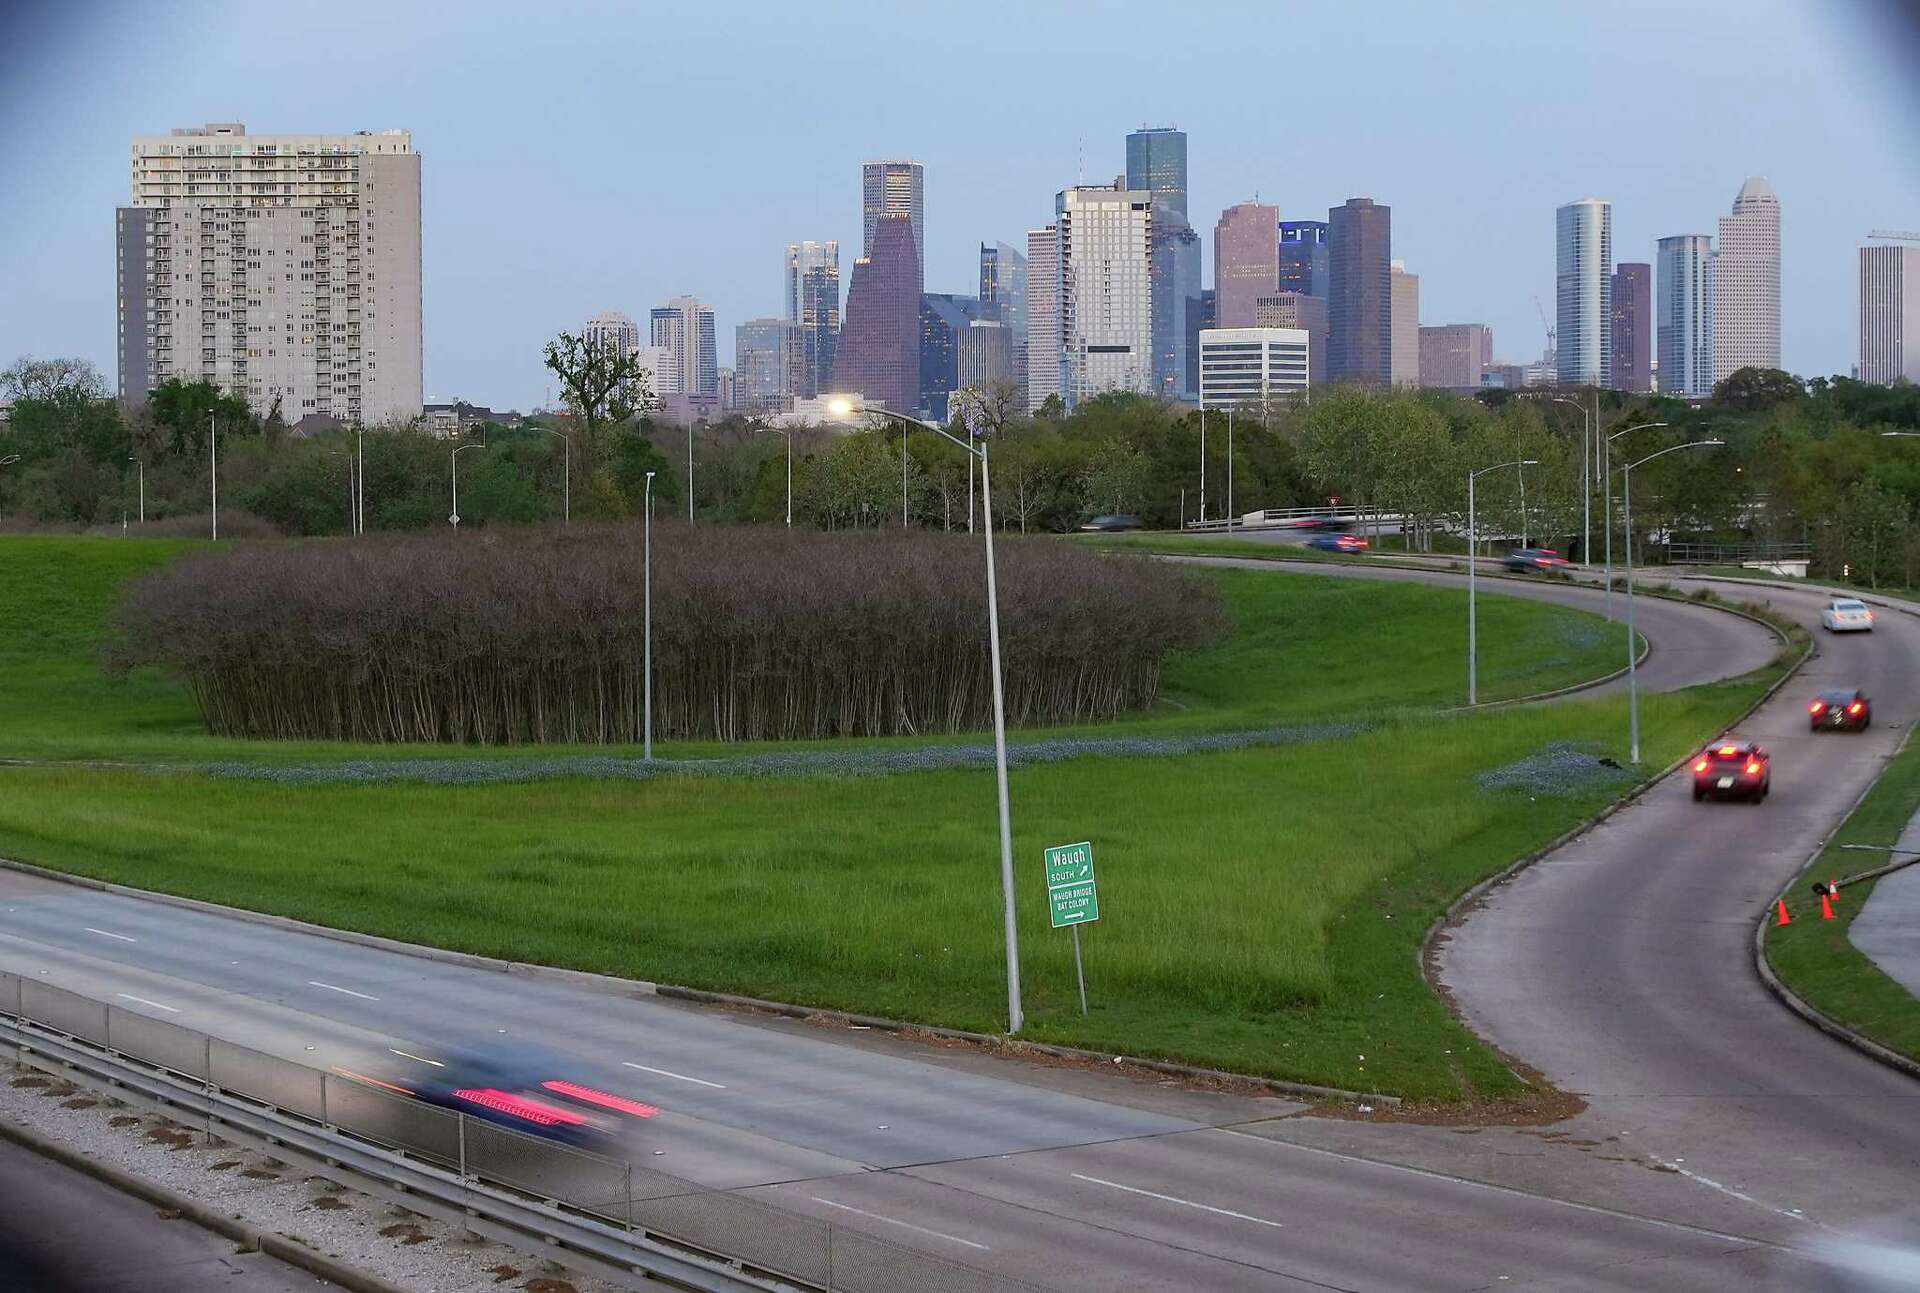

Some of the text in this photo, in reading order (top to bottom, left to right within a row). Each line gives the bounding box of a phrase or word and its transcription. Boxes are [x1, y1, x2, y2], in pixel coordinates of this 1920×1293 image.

[1052, 848, 1085, 867] Waugh
[1051, 871, 1075, 882] SOUTH
[1053, 887, 1092, 901] WAUGH BRIDGE
[1058, 899, 1089, 911] BAT COLONY
